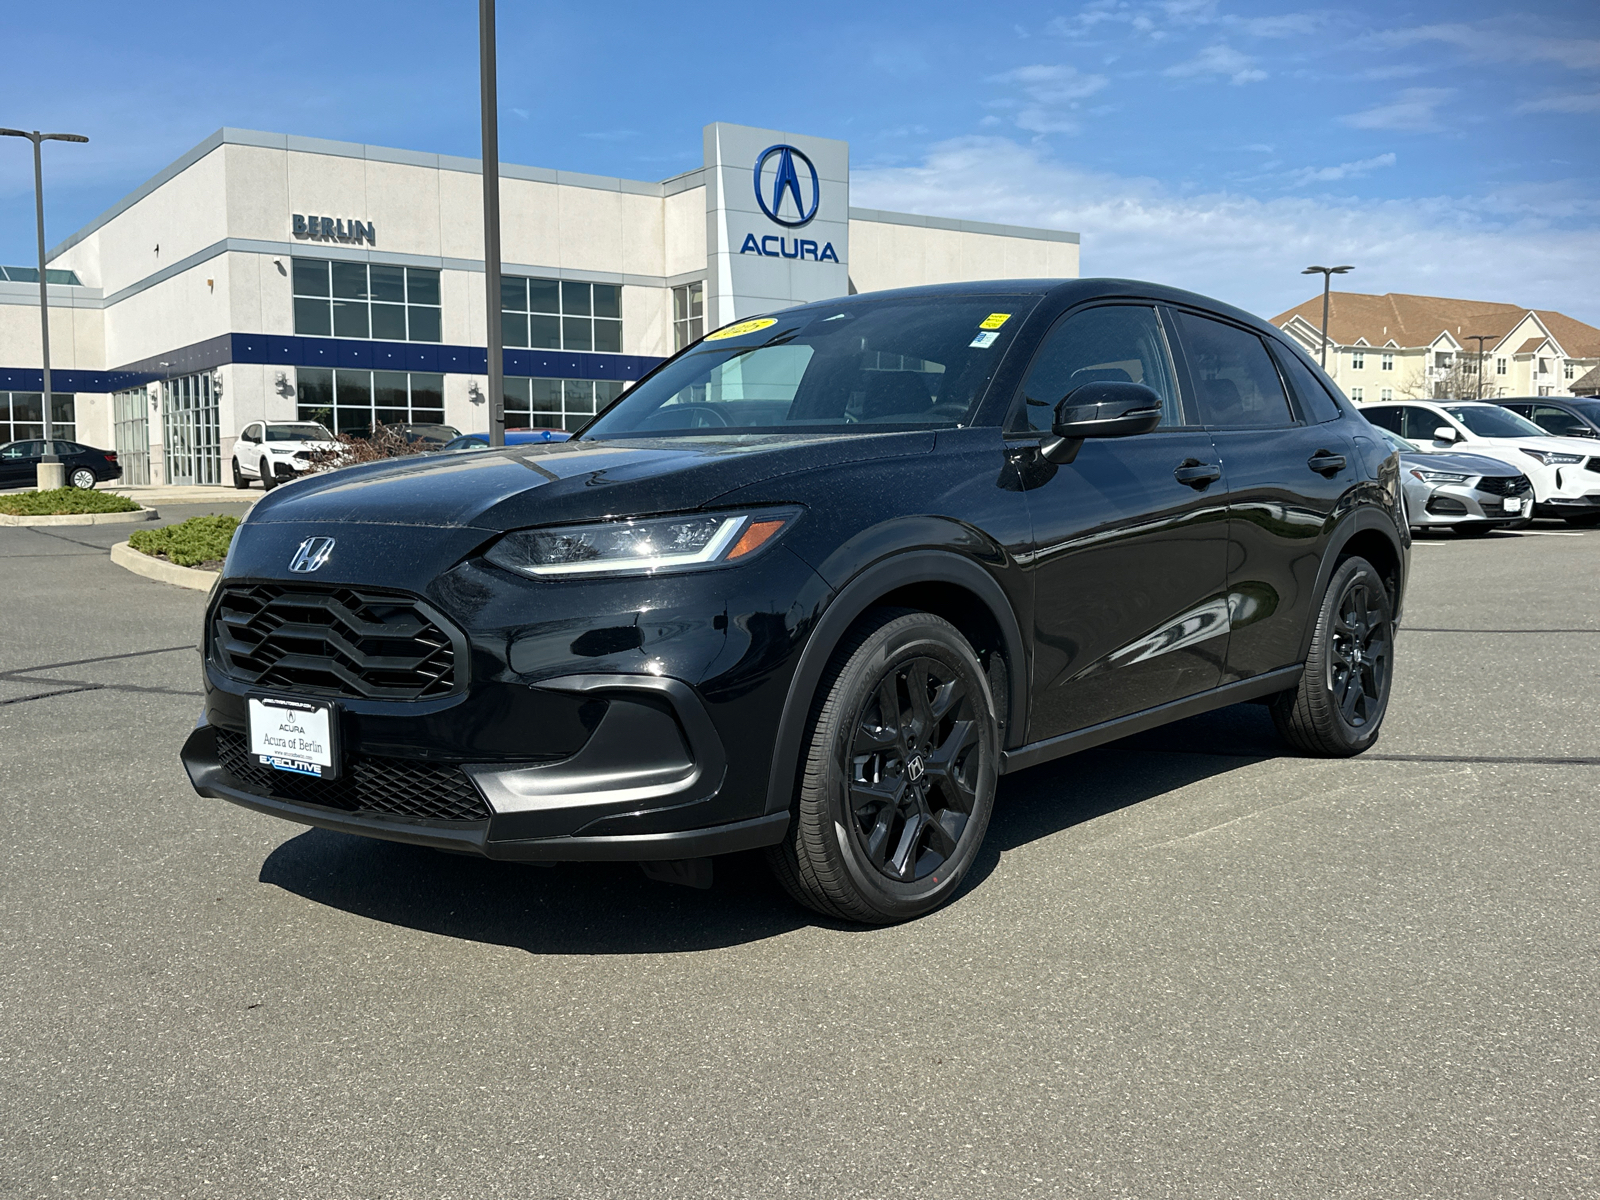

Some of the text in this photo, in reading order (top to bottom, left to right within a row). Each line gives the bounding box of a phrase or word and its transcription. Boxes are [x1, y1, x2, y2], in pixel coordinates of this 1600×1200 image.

[292, 213, 373, 241] BERLIN
[740, 233, 839, 264] ACURA
[279, 724, 306, 735] ACURA
[263, 733, 323, 754] Acura of Berlin
[259, 755, 322, 773] EXECUTIVE
